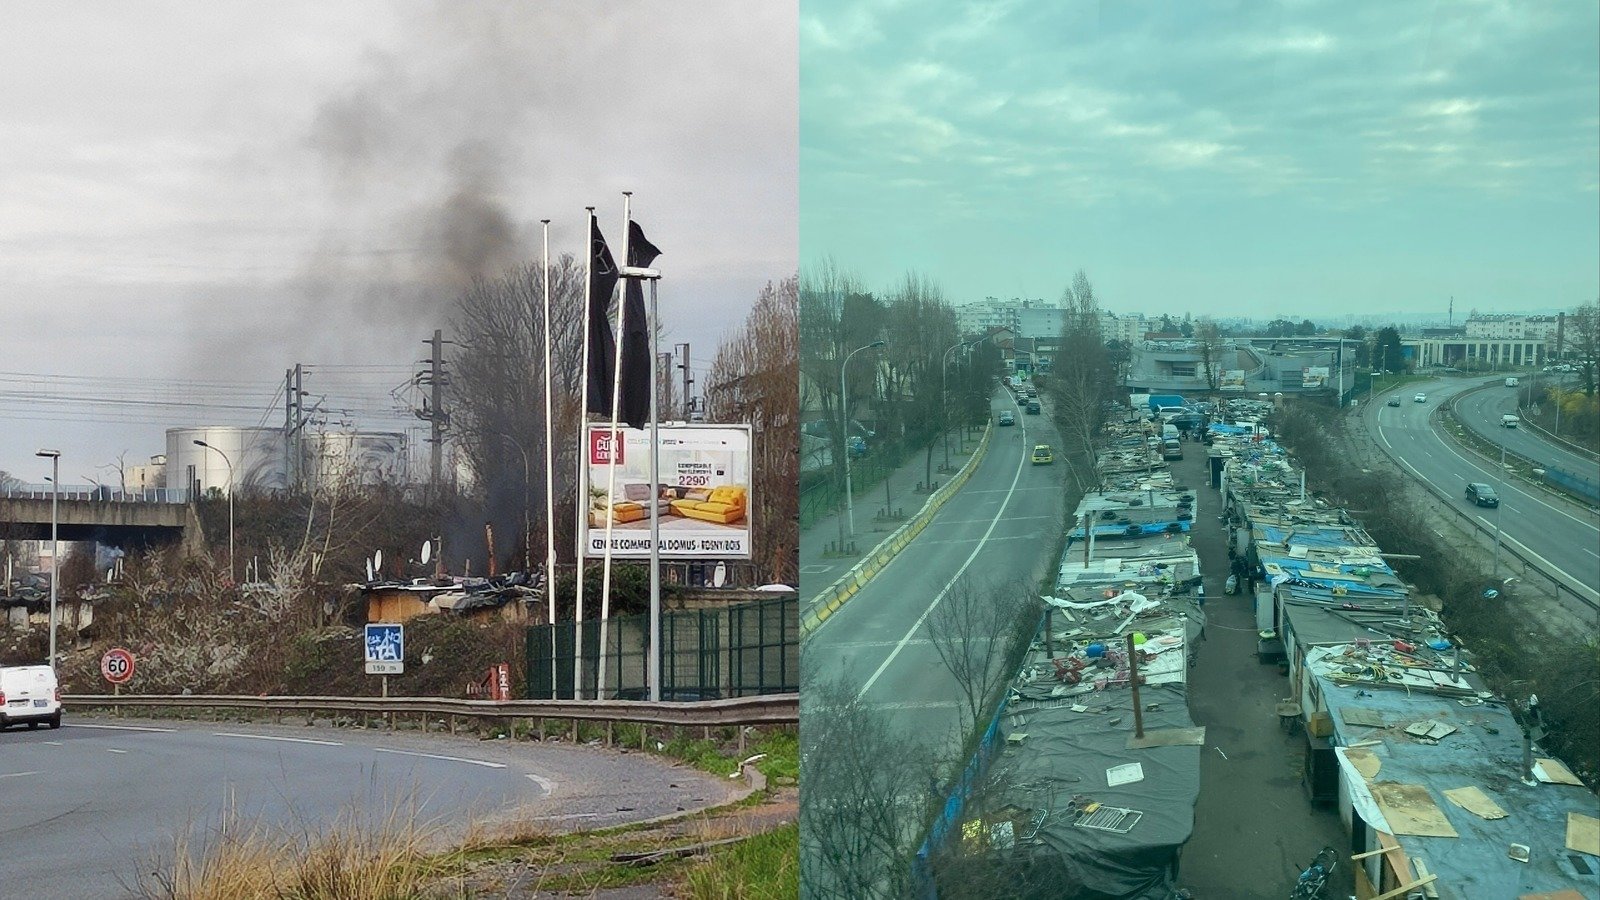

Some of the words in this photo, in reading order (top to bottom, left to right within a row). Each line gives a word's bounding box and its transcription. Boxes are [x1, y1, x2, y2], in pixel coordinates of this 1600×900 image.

[592, 539, 619, 550] CENRE
[620, 539, 667, 550] COMMERAL
[668, 540, 696, 550] DOMUS
[108, 659, 127, 673] 60
